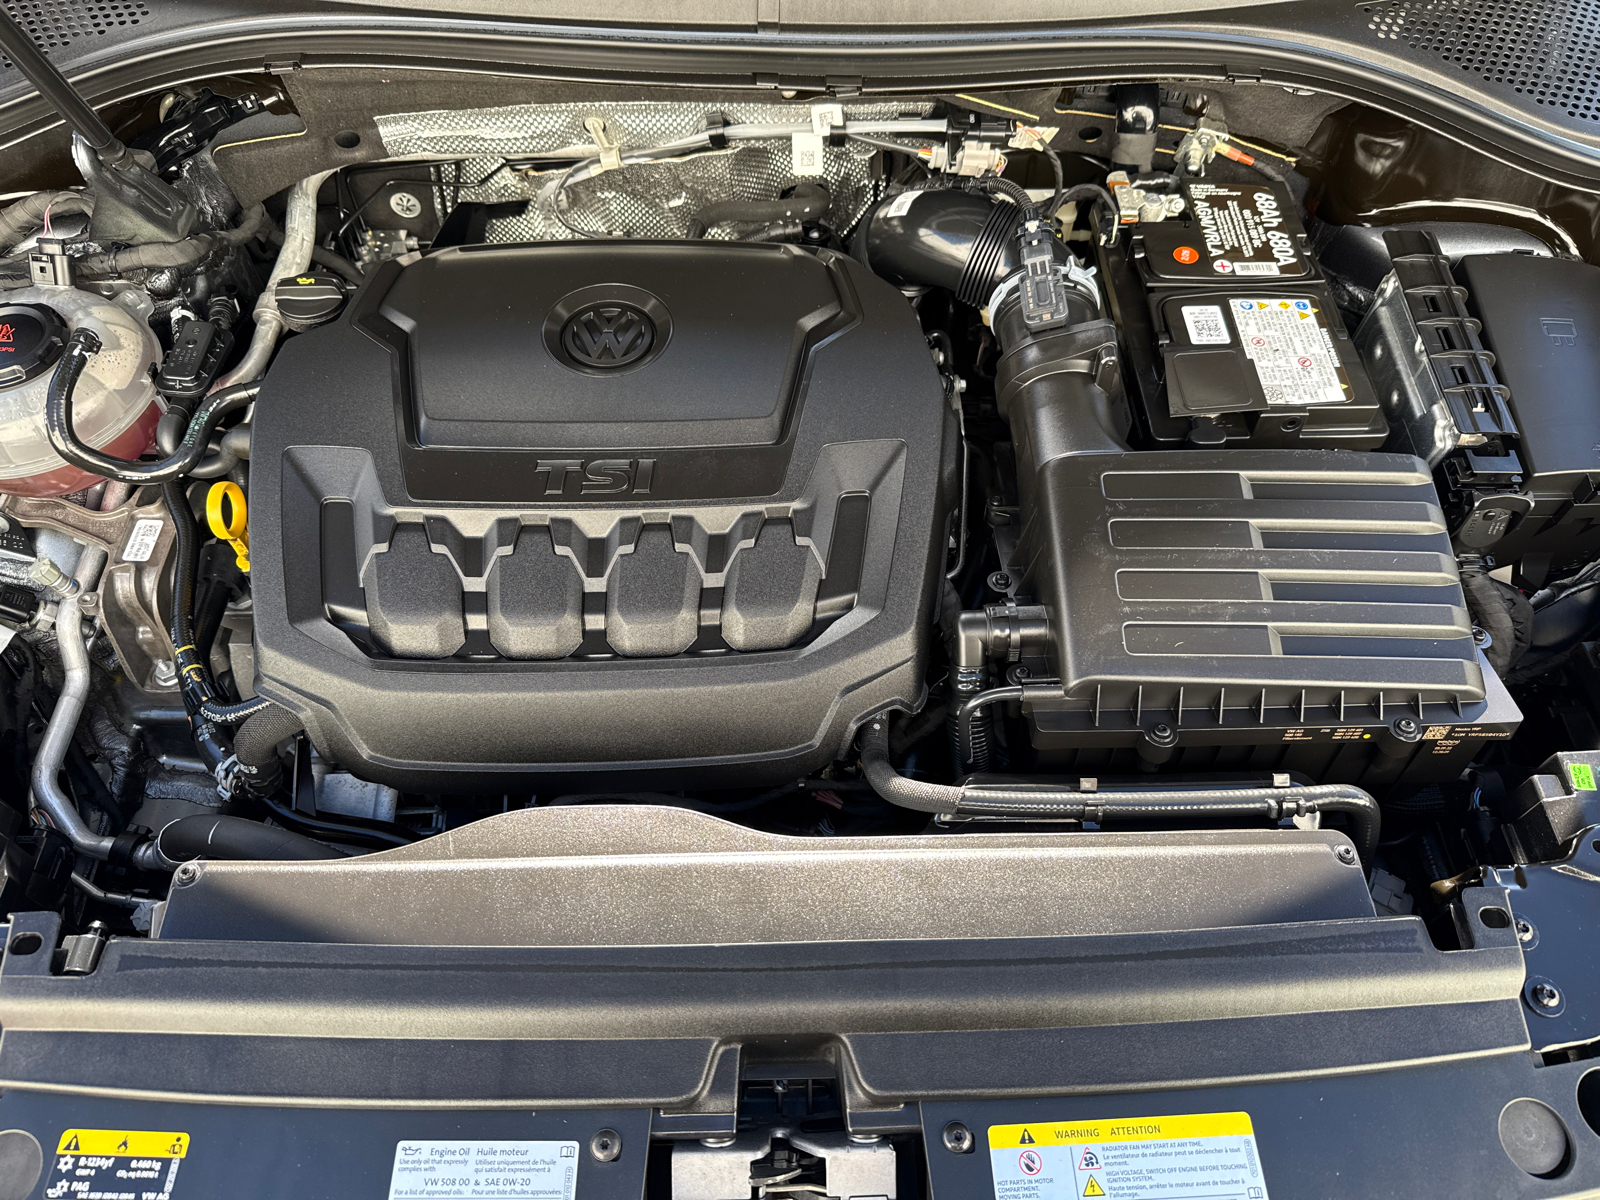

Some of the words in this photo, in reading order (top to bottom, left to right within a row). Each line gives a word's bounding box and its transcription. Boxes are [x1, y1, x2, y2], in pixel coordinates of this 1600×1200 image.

[1253, 192, 1282, 227] 68Ah
[1266, 230, 1298, 266] 680A
[534, 458, 657, 495] TSI
[1054, 1128, 1100, 1139] WARNING
[1110, 1125, 1161, 1136] ATTENTION
[430, 1148, 457, 1158] Engine
[78, 1157, 115, 1170] R-1234yf
[152, 1160, 162, 1170] kg
[71, 1181, 90, 1191] PAG
[485, 1178, 500, 1186] SAE
[502, 1178, 530, 1186] 0W-20
[142, 1192, 156, 1200] VW
